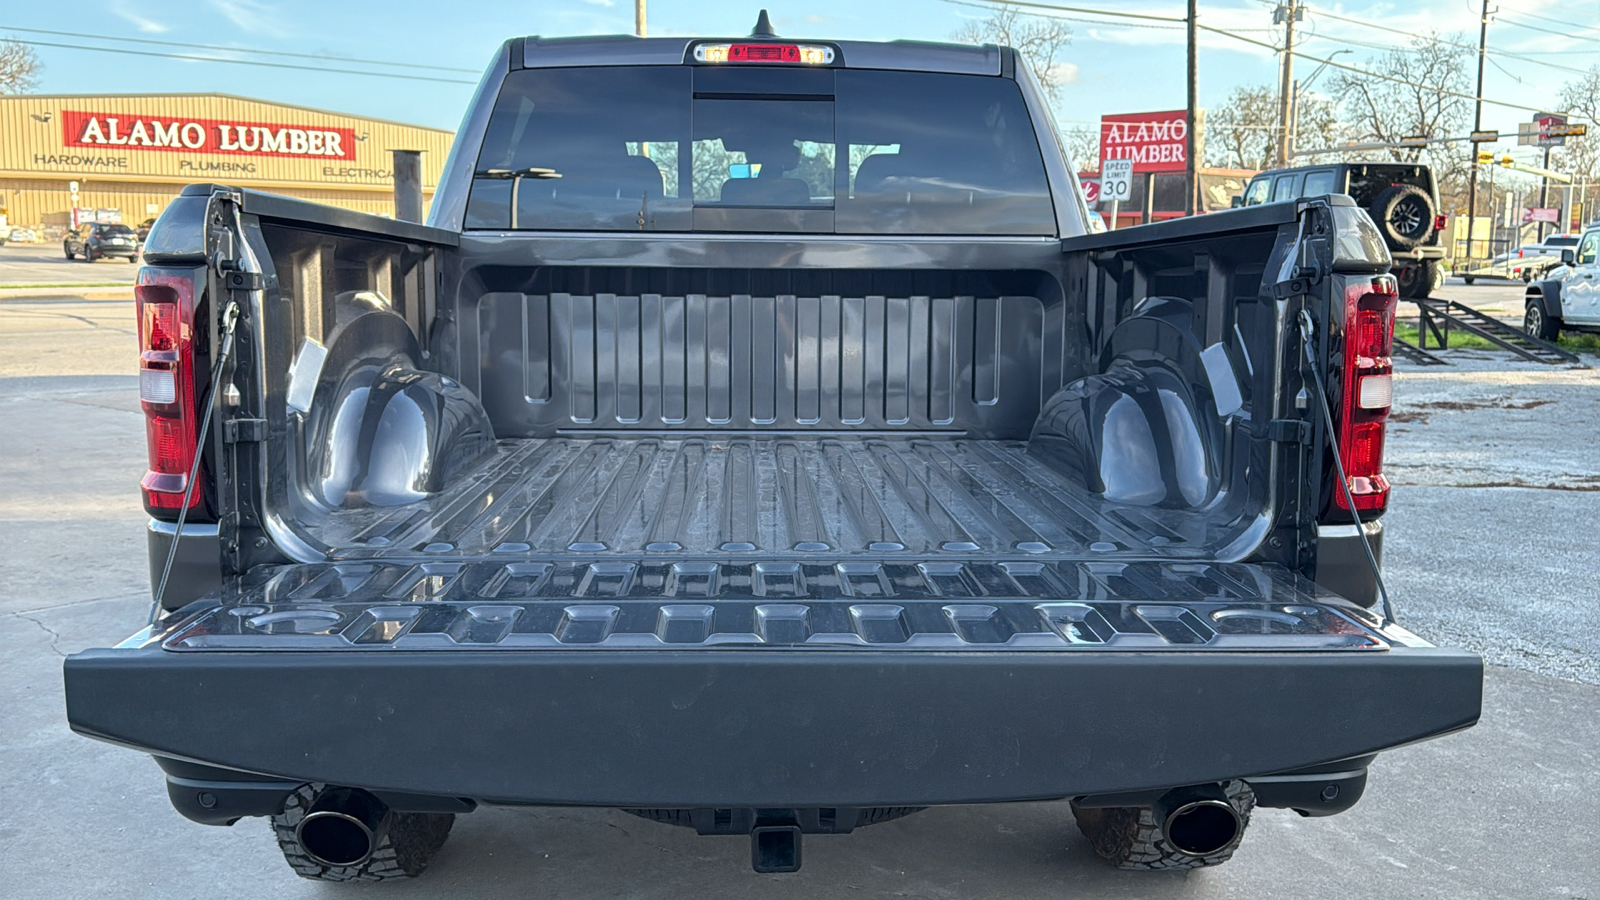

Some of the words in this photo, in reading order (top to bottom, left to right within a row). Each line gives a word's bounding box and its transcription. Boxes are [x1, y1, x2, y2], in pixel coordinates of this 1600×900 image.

[81, 115, 206, 149] ALAMO
[219, 124, 345, 156] LUMBER
[1106, 118, 1187, 144] ALAMO
[34, 153, 128, 168] HARDWARE
[180, 160, 257, 173] PLUMBING
[1105, 162, 1130, 171] SPEED
[323, 166, 394, 179] ELECTRICA
[1103, 180, 1127, 195] 30
